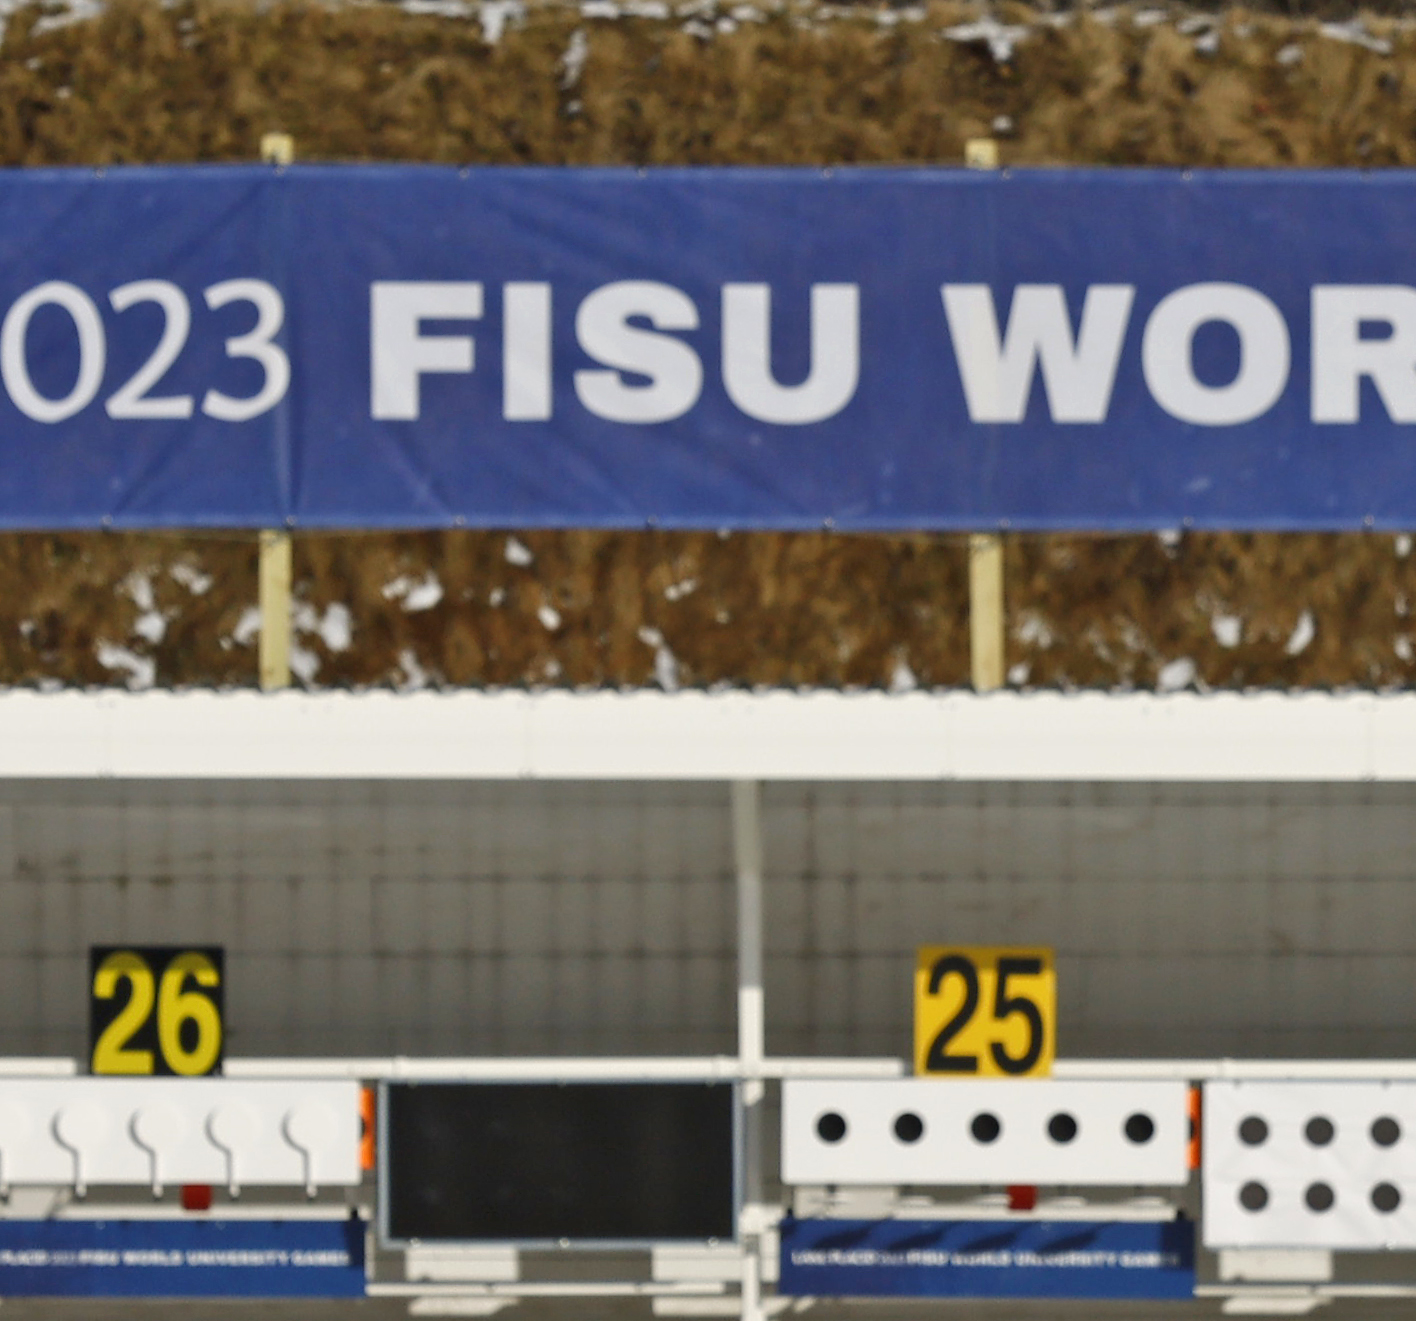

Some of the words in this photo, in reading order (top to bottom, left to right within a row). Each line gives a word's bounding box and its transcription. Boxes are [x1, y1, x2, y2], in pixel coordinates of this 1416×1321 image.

[1, 279, 291, 423] 023
[370, 281, 859, 424] FISU
[92, 952, 222, 1075] 26
[925, 955, 1044, 1075] 25
